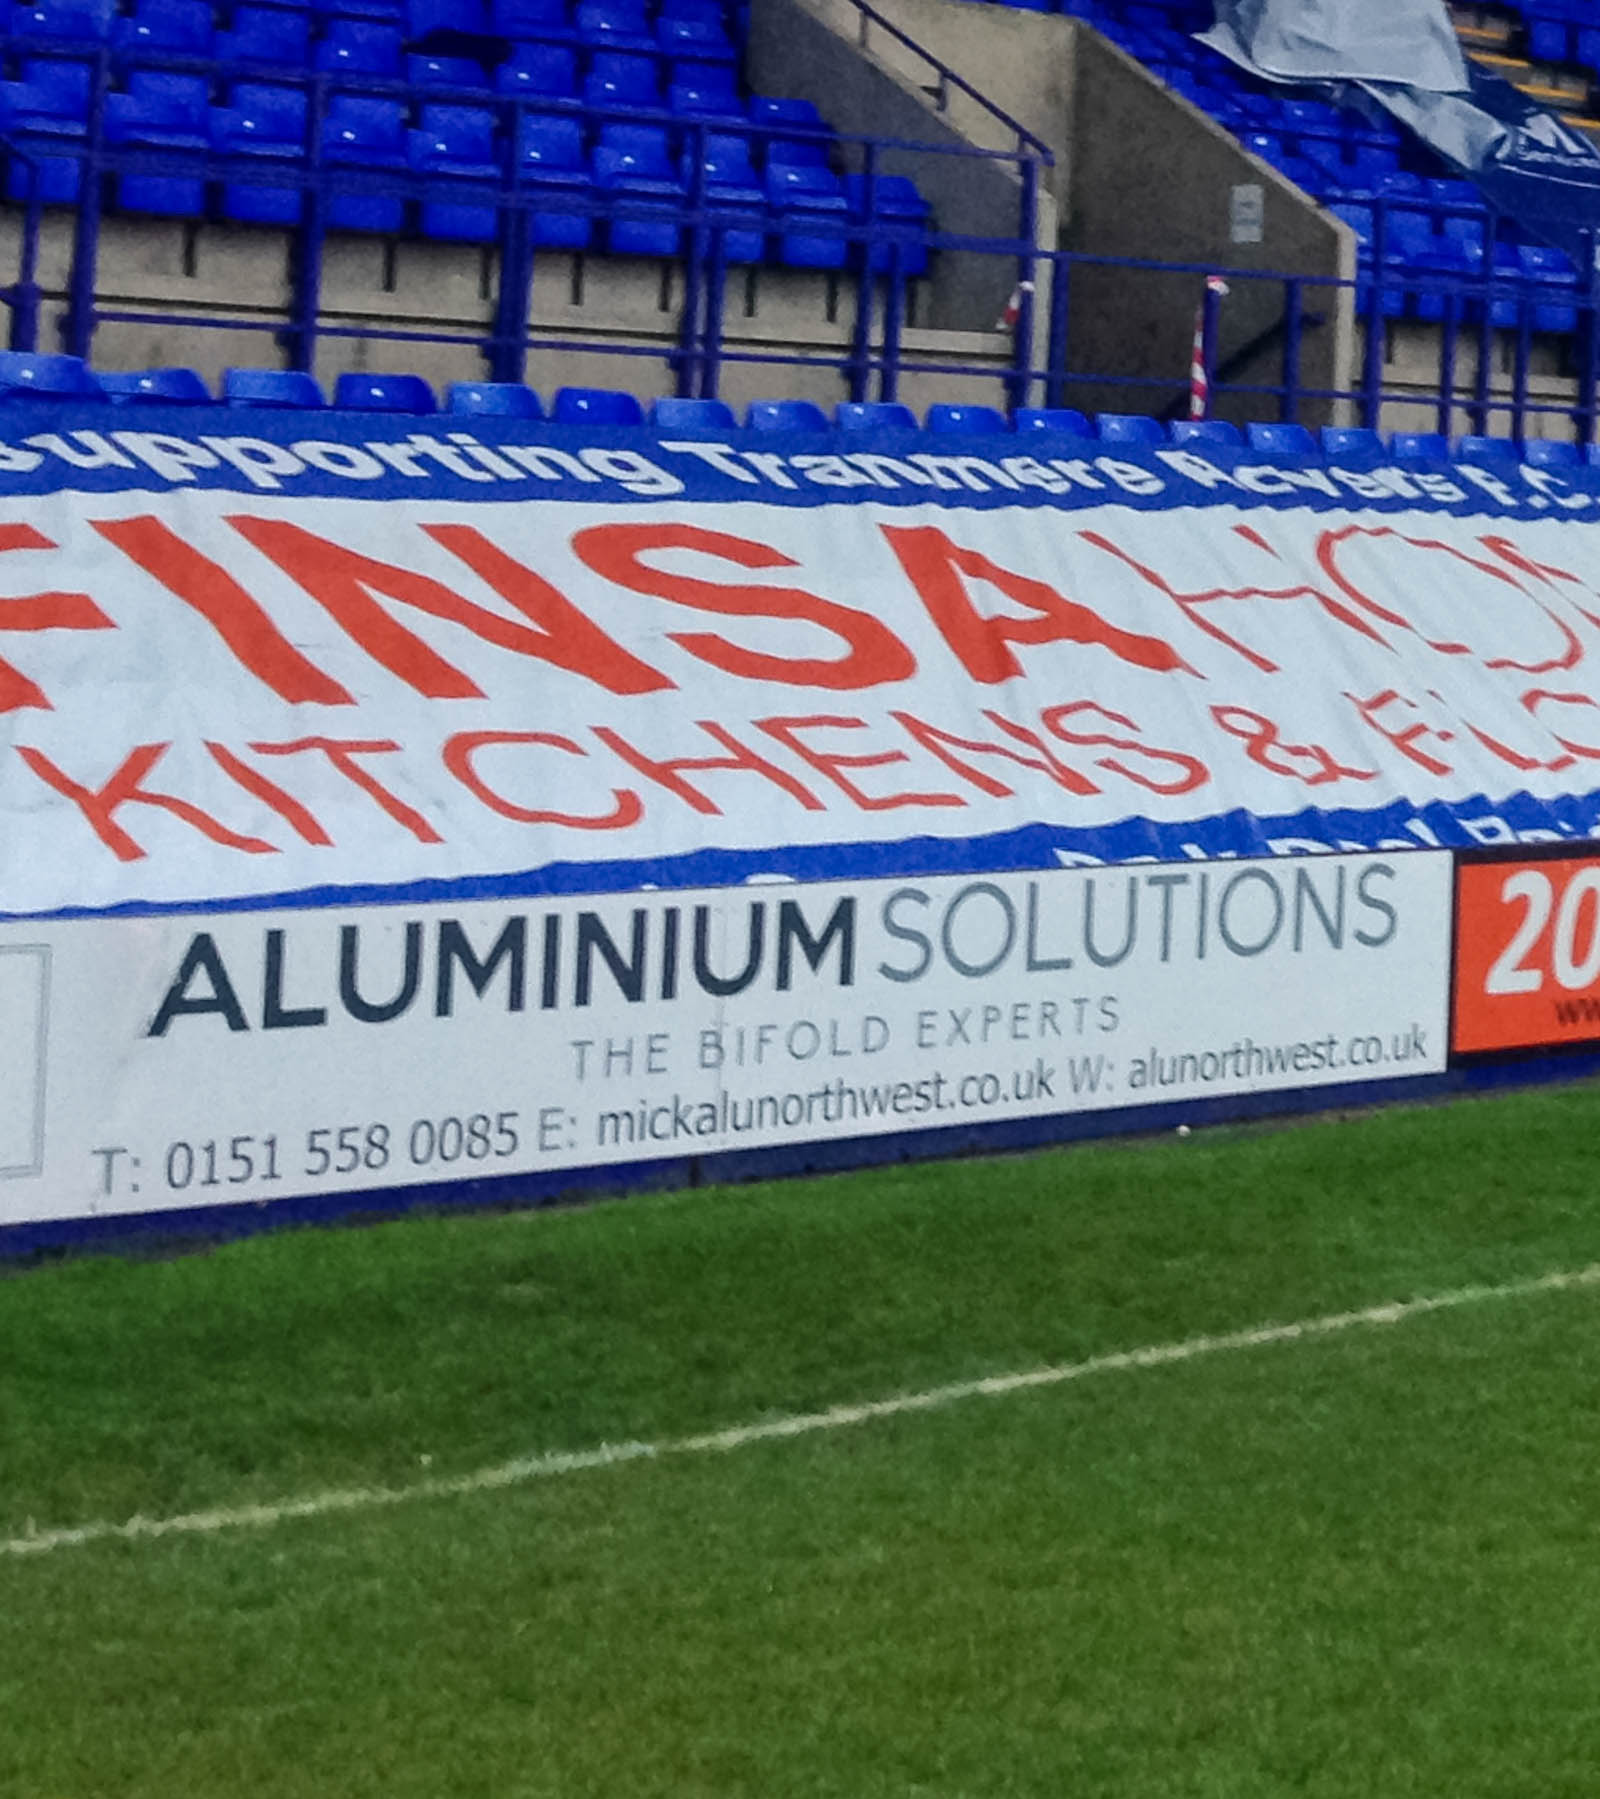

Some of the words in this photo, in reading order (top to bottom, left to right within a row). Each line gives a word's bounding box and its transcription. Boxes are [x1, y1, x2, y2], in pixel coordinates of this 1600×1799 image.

[658, 440, 1166, 495] Tranmere
[15, 699, 1210, 862] KITCHENS
[1210, 705, 1382, 784] &
[146, 897, 857, 1038] ALUMINIUM
[877, 862, 1399, 983] SOLUTIONS
[91, 1146, 142, 1196] T:
[165, 1134, 280, 1190] 0151
[304, 1122, 391, 1178] 558
[409, 1112, 521, 1167] 0085
[538, 1106, 579, 1152] E:
[1068, 1057, 1115, 1095] W:
[1129, 1023, 1427, 1090] alunorthwest.co.uk
[571, 1032, 668, 1084] THE
[699, 1014, 890, 1071] BIFOLD
[916, 996, 1122, 1051] EXPERTS
